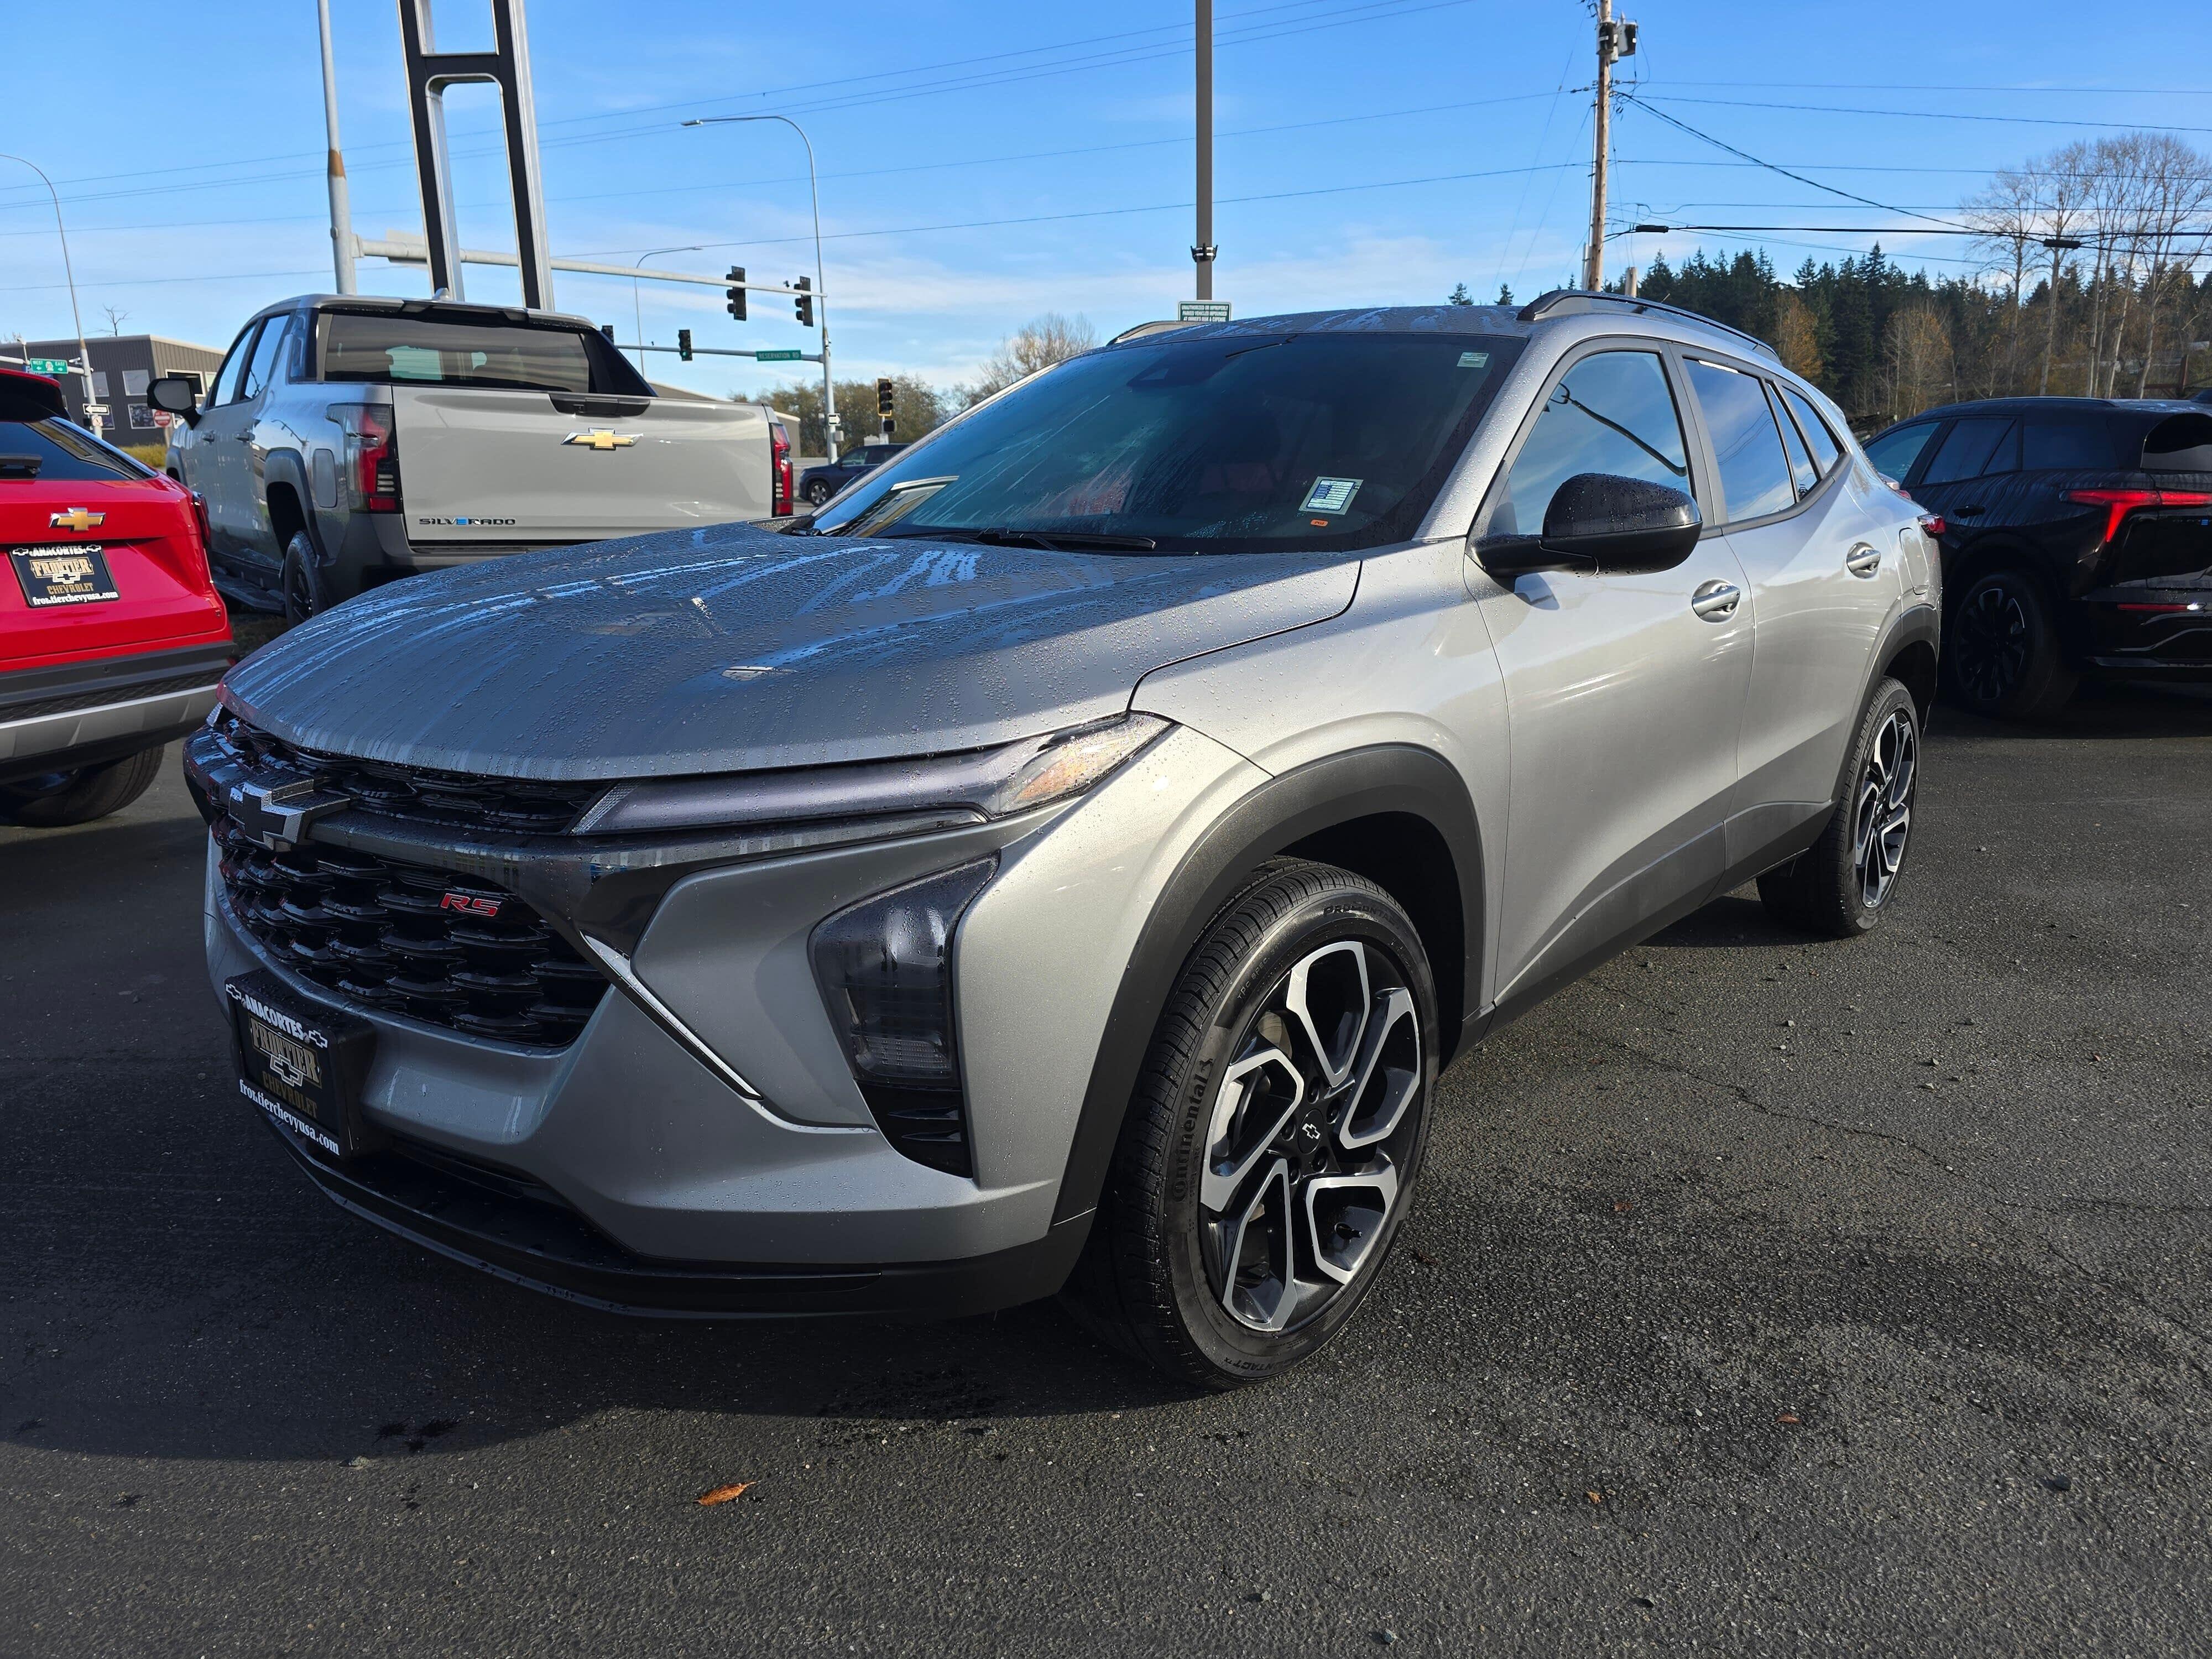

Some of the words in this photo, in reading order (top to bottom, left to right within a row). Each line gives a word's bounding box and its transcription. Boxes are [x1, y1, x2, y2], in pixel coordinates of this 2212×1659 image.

[419, 517, 515, 525] SILVERADO
[32, 545, 82, 556] ANACORTES
[32, 559, 92, 576] FRONTIER
[46, 583, 93, 595] CHEVROLET
[441, 893, 502, 916] RS
[245, 994, 304, 1041] ANACORTES
[251, 1018, 320, 1083] FRONTIER
[262, 1070, 318, 1118] CHEVROLET
[1172, 1073, 1209, 1203] Continental
